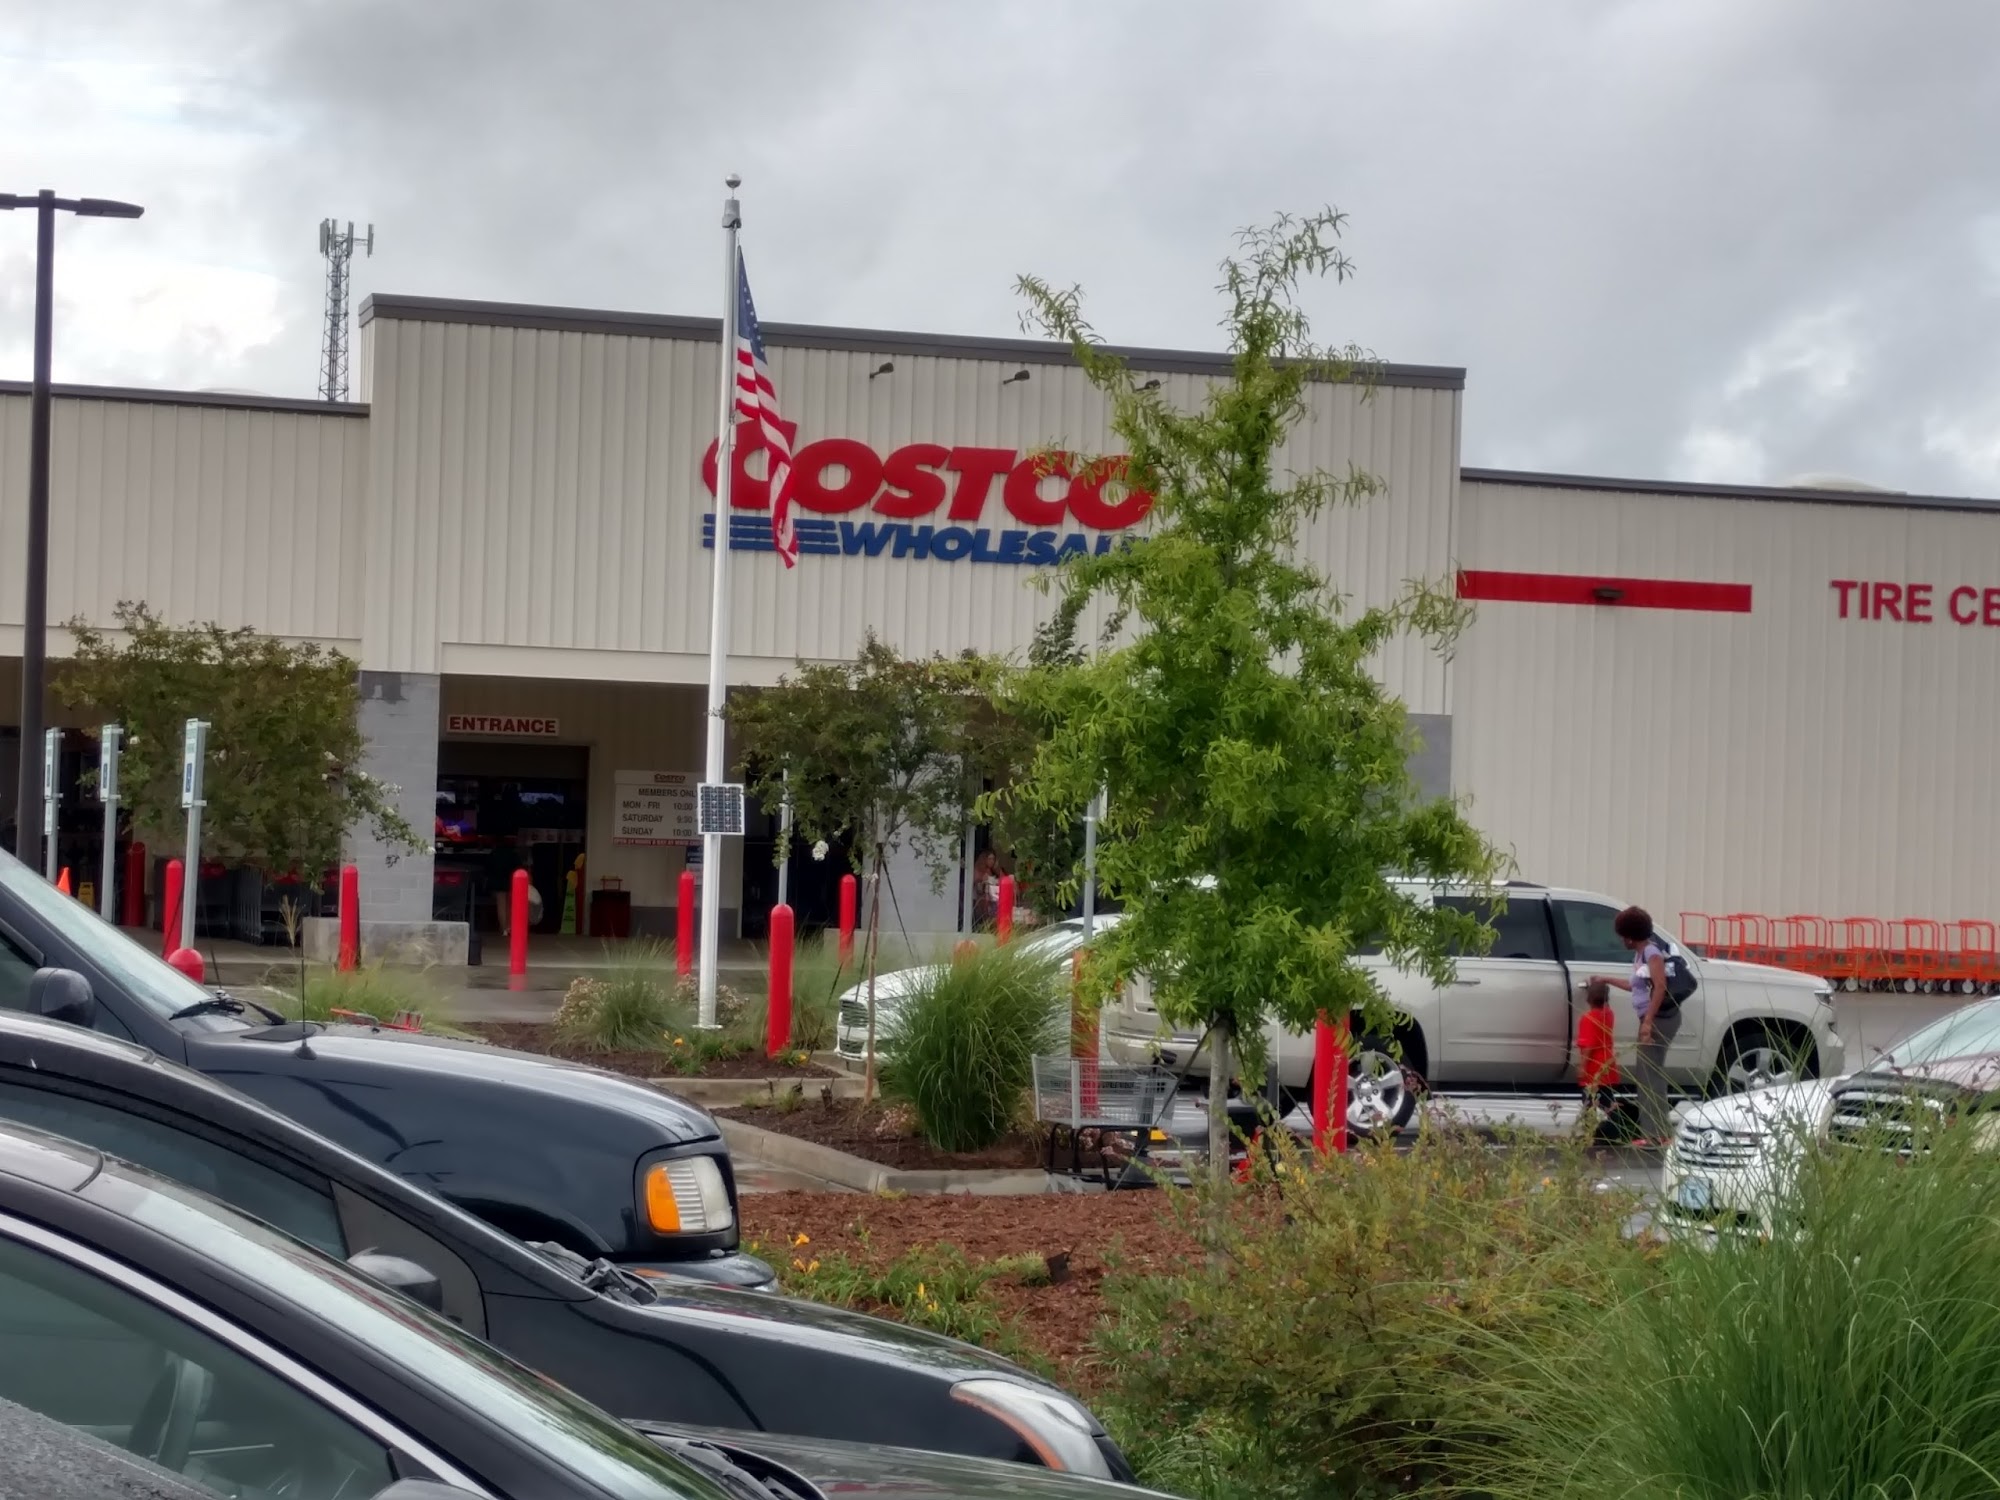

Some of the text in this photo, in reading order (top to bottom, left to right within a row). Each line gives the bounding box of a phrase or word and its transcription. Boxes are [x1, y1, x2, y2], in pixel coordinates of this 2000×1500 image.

[702, 419, 1159, 531] COSTCO
[839, 521, 1150, 567] WHOLESA
[1831, 580, 1933, 623] TIRE
[449, 716, 557, 734] ENTRANCE
[638, 788, 699, 798] MEMBERS ONL
[622, 800, 641, 809] MON
[647, 801, 660, 810] FRI
[673, 802, 693, 811] 10:00
[622, 813, 663, 823] SATURDAY
[621, 826, 693, 837] SUNDAY 10:00
